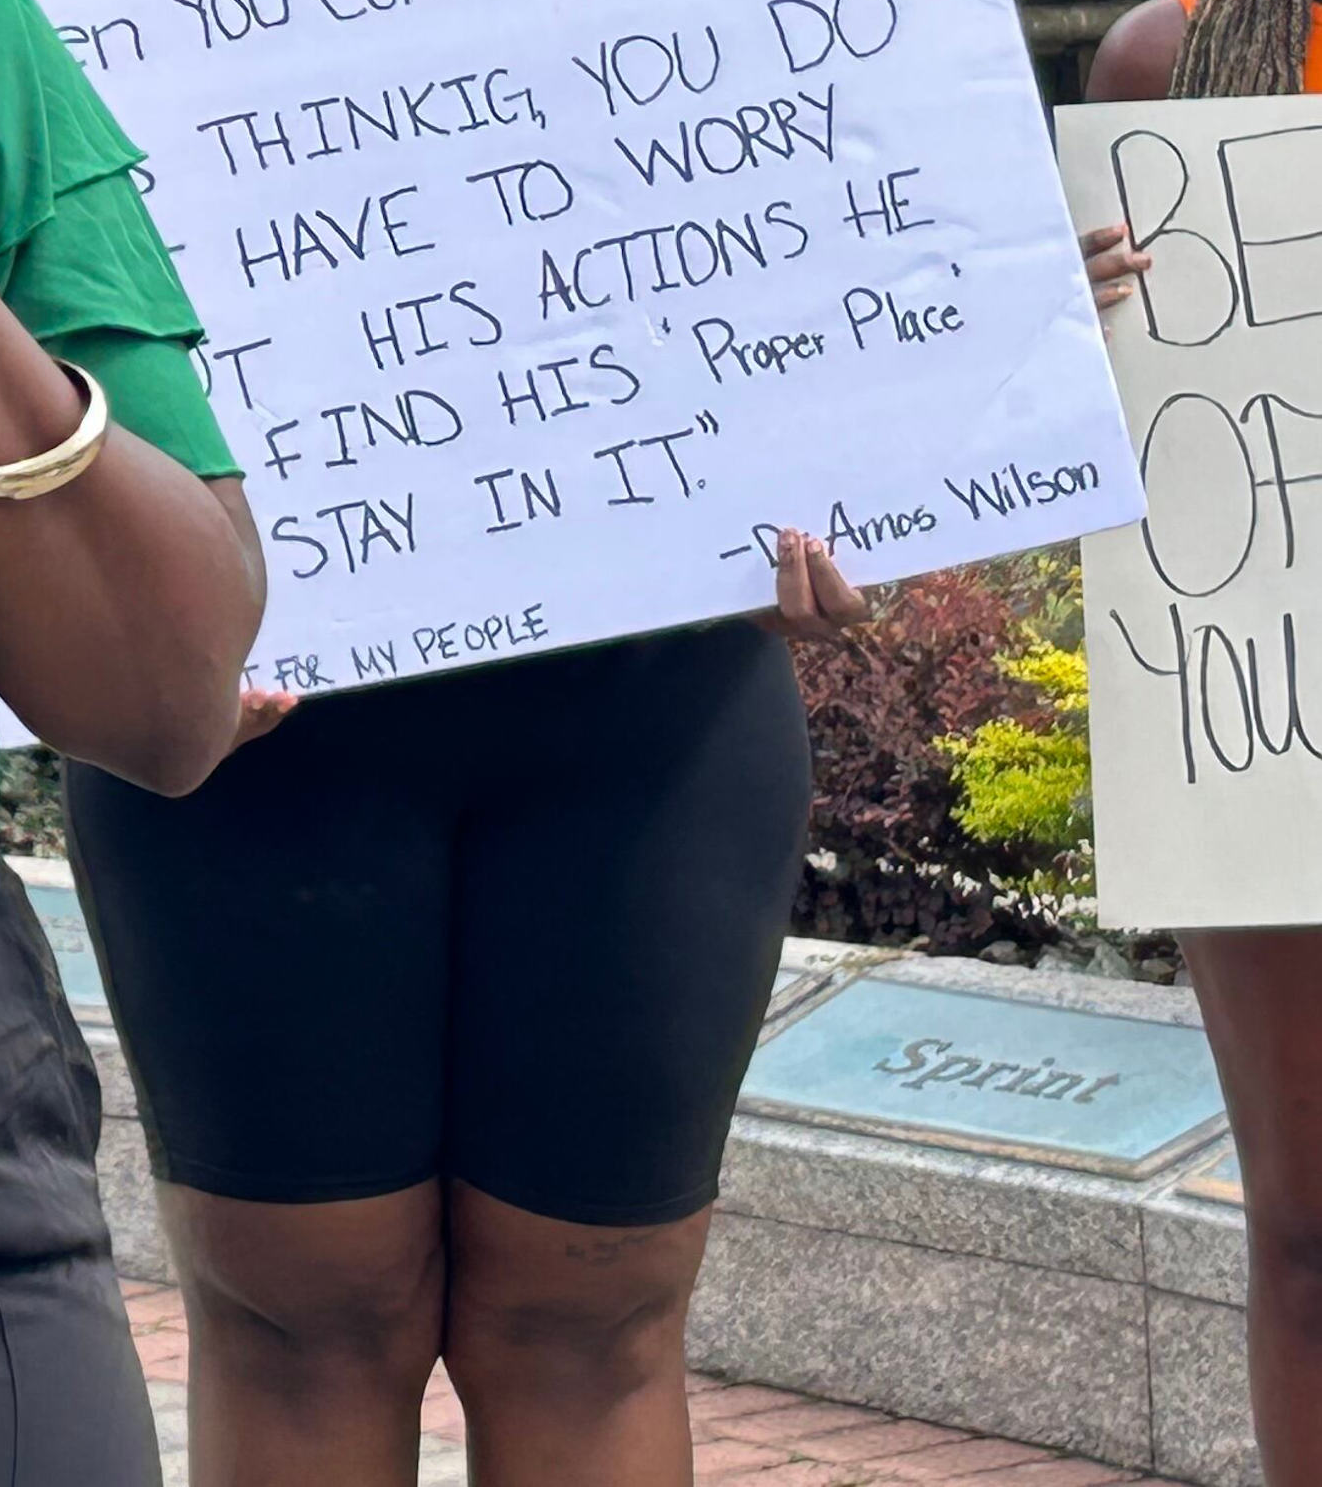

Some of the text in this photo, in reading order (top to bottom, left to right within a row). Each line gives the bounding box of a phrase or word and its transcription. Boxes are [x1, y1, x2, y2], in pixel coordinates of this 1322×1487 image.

[571, 25, 721, 115] YOU
[235, 82, 835, 288] HAVE TO WORRY
[360, 281, 503, 370] HIS
[538, 201, 809, 321] ACTIONS
[843, 167, 936, 239] HE
[265, 389, 463, 480] FIND
[498, 342, 642, 425] HIS
[271, 492, 418, 580] STAY
[473, 467, 562, 534] IN
[943, 460, 1099, 521] Wilson
[274, 654, 336, 692] FOR
[350, 640, 398, 680] MY
[411, 602, 550, 665] PEOPLE
[872, 1038, 1120, 1104] Sprint
